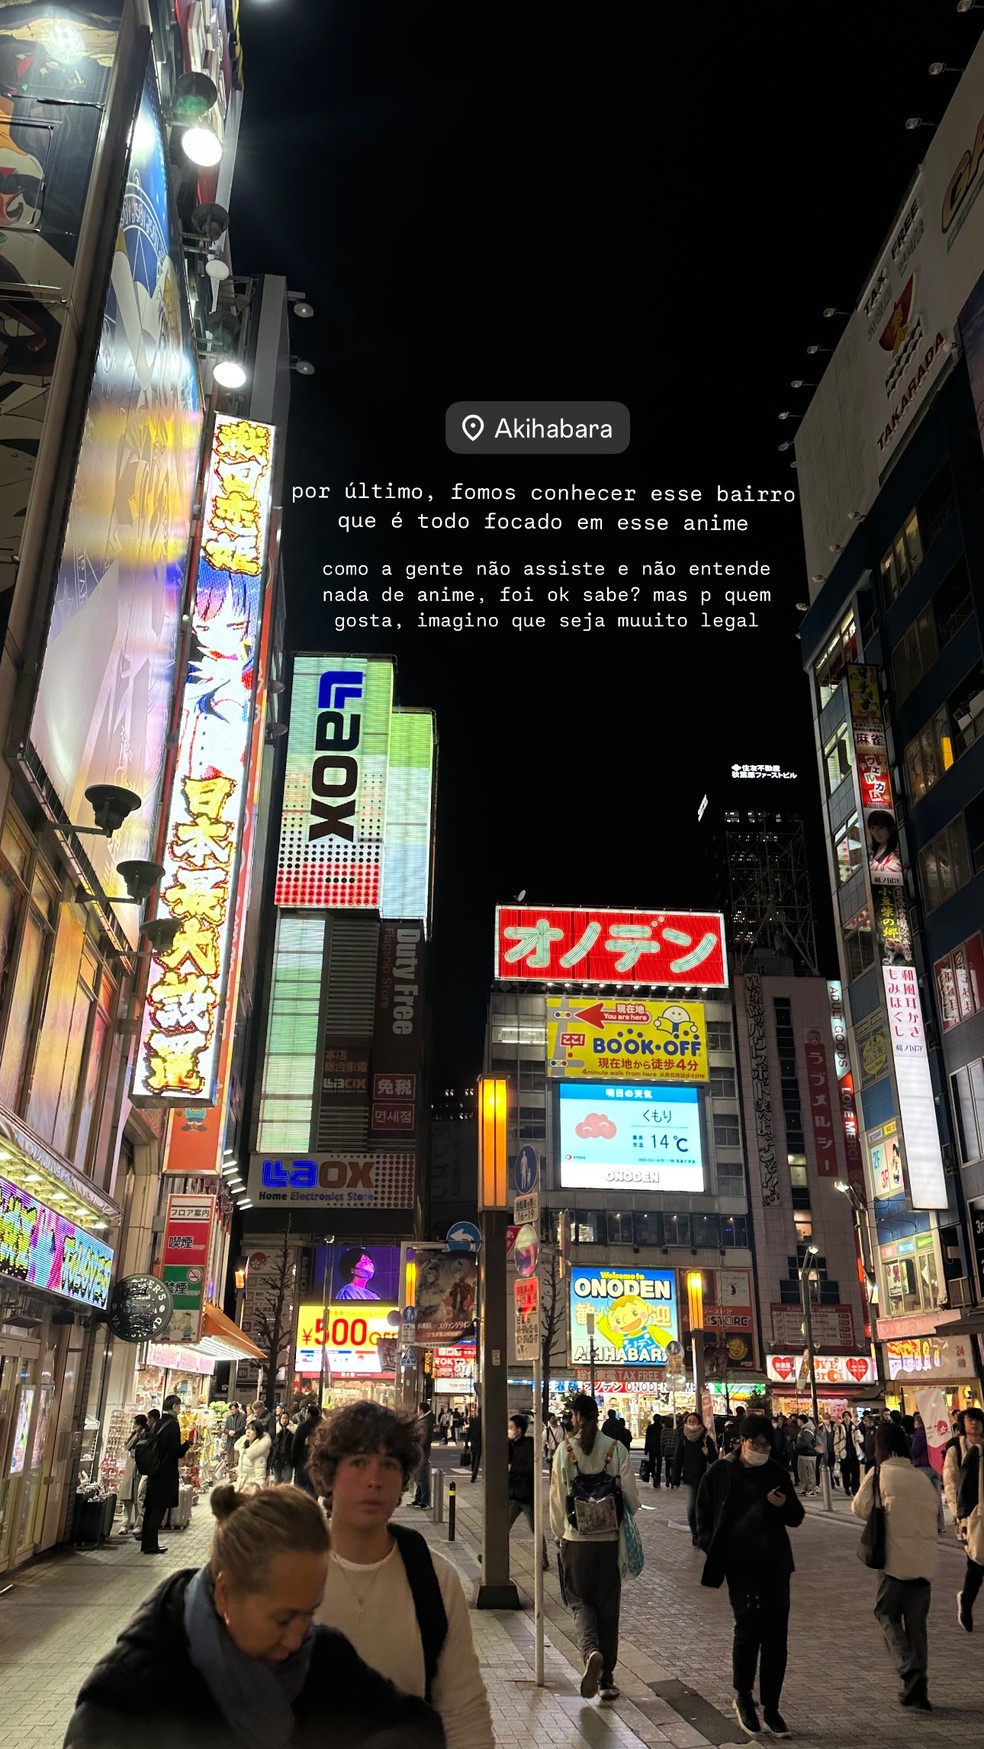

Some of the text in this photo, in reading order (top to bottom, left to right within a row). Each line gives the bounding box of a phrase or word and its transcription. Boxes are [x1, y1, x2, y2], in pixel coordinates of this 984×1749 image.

[864, 267, 888, 318] TAX
[891, 199, 921, 261] FREE
[877, 331, 945, 451] TAKARADA
[856, 733, 884, 746] 麻雀
[146, 774, 236, 1094] 日本最大設置
[503, 915, 718, 974] オノデン
[381, 927, 395, 1009] Flagship Store
[392, 928, 421, 1035] Duty Free
[604, 1012, 647, 1021] You are here
[616, 1004, 646, 1014] 現在地
[829, 985, 848, 1068] ADULT GOODS
[562, 1035, 584, 1046] ここ!
[597, 1057, 699, 1072] 現在地から徒歩4分
[377, 1078, 412, 1095] 免税
[605, 1088, 653, 1099] 明日の天気
[374, 1109, 412, 1124] 면세점
[642, 1109, 673, 1124] くもり
[808, 1050, 833, 1173] ラブメルシー
[841, 1087, 859, 1161] LOVE MERCI
[605, 1170, 660, 1184] ONODEN
[259, 1191, 374, 1202] Home Electronics Store
[171, 1208, 210, 1218] フロア案内
[169, 1235, 193, 1249] 喫煙
[600, 1271, 645, 1280] Welcome to
[573, 1278, 672, 1300] ONODEN
[302, 1318, 368, 1346] ¥500
[955, 1345, 965, 1356] 24
[814, 1357, 839, 1370] OVE
[618, 1370, 636, 1381] TAX
[637, 1370, 660, 1382] FREE
